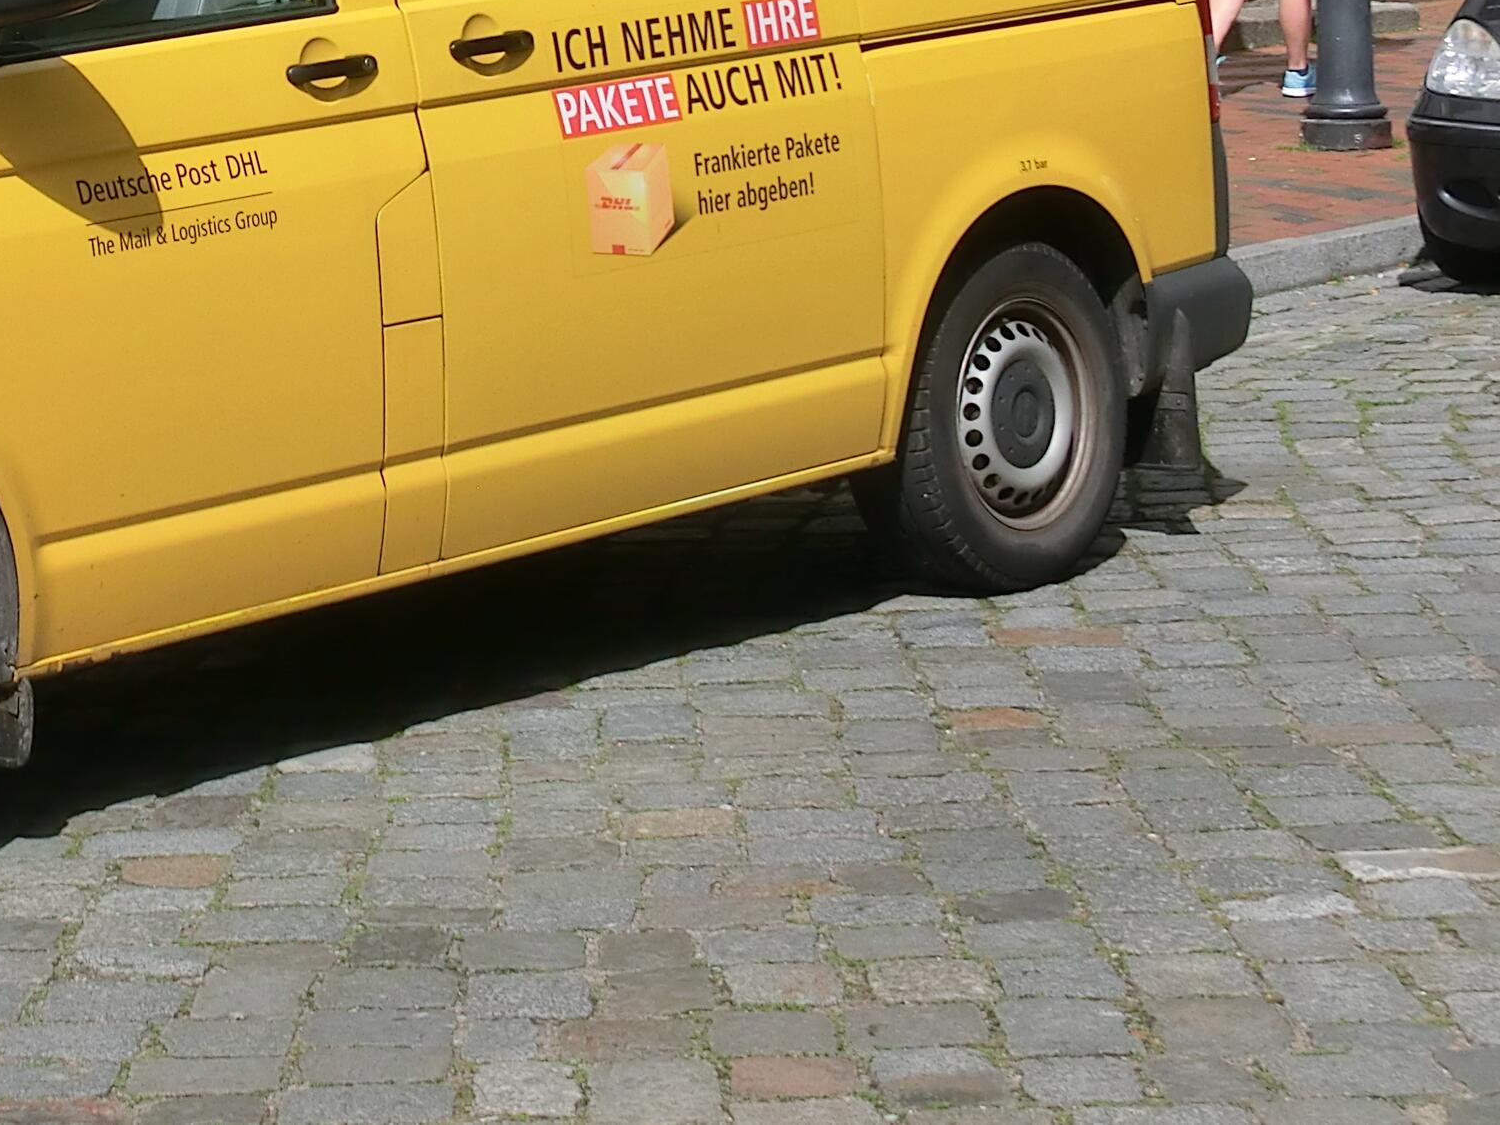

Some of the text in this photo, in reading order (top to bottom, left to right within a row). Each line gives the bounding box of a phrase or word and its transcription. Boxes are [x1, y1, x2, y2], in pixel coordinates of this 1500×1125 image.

[551, 25, 609, 73] ICH
[620, 7, 737, 63] NEHME
[556, 51, 843, 135] PAKETE AUCH MIT!
[76, 150, 268, 206] Deutsche Post DHL
[694, 132, 841, 177] Frankierte Pakete
[697, 172, 816, 216] hier abgeben!
[88, 208, 278, 257] The Mail & Logistics Group
